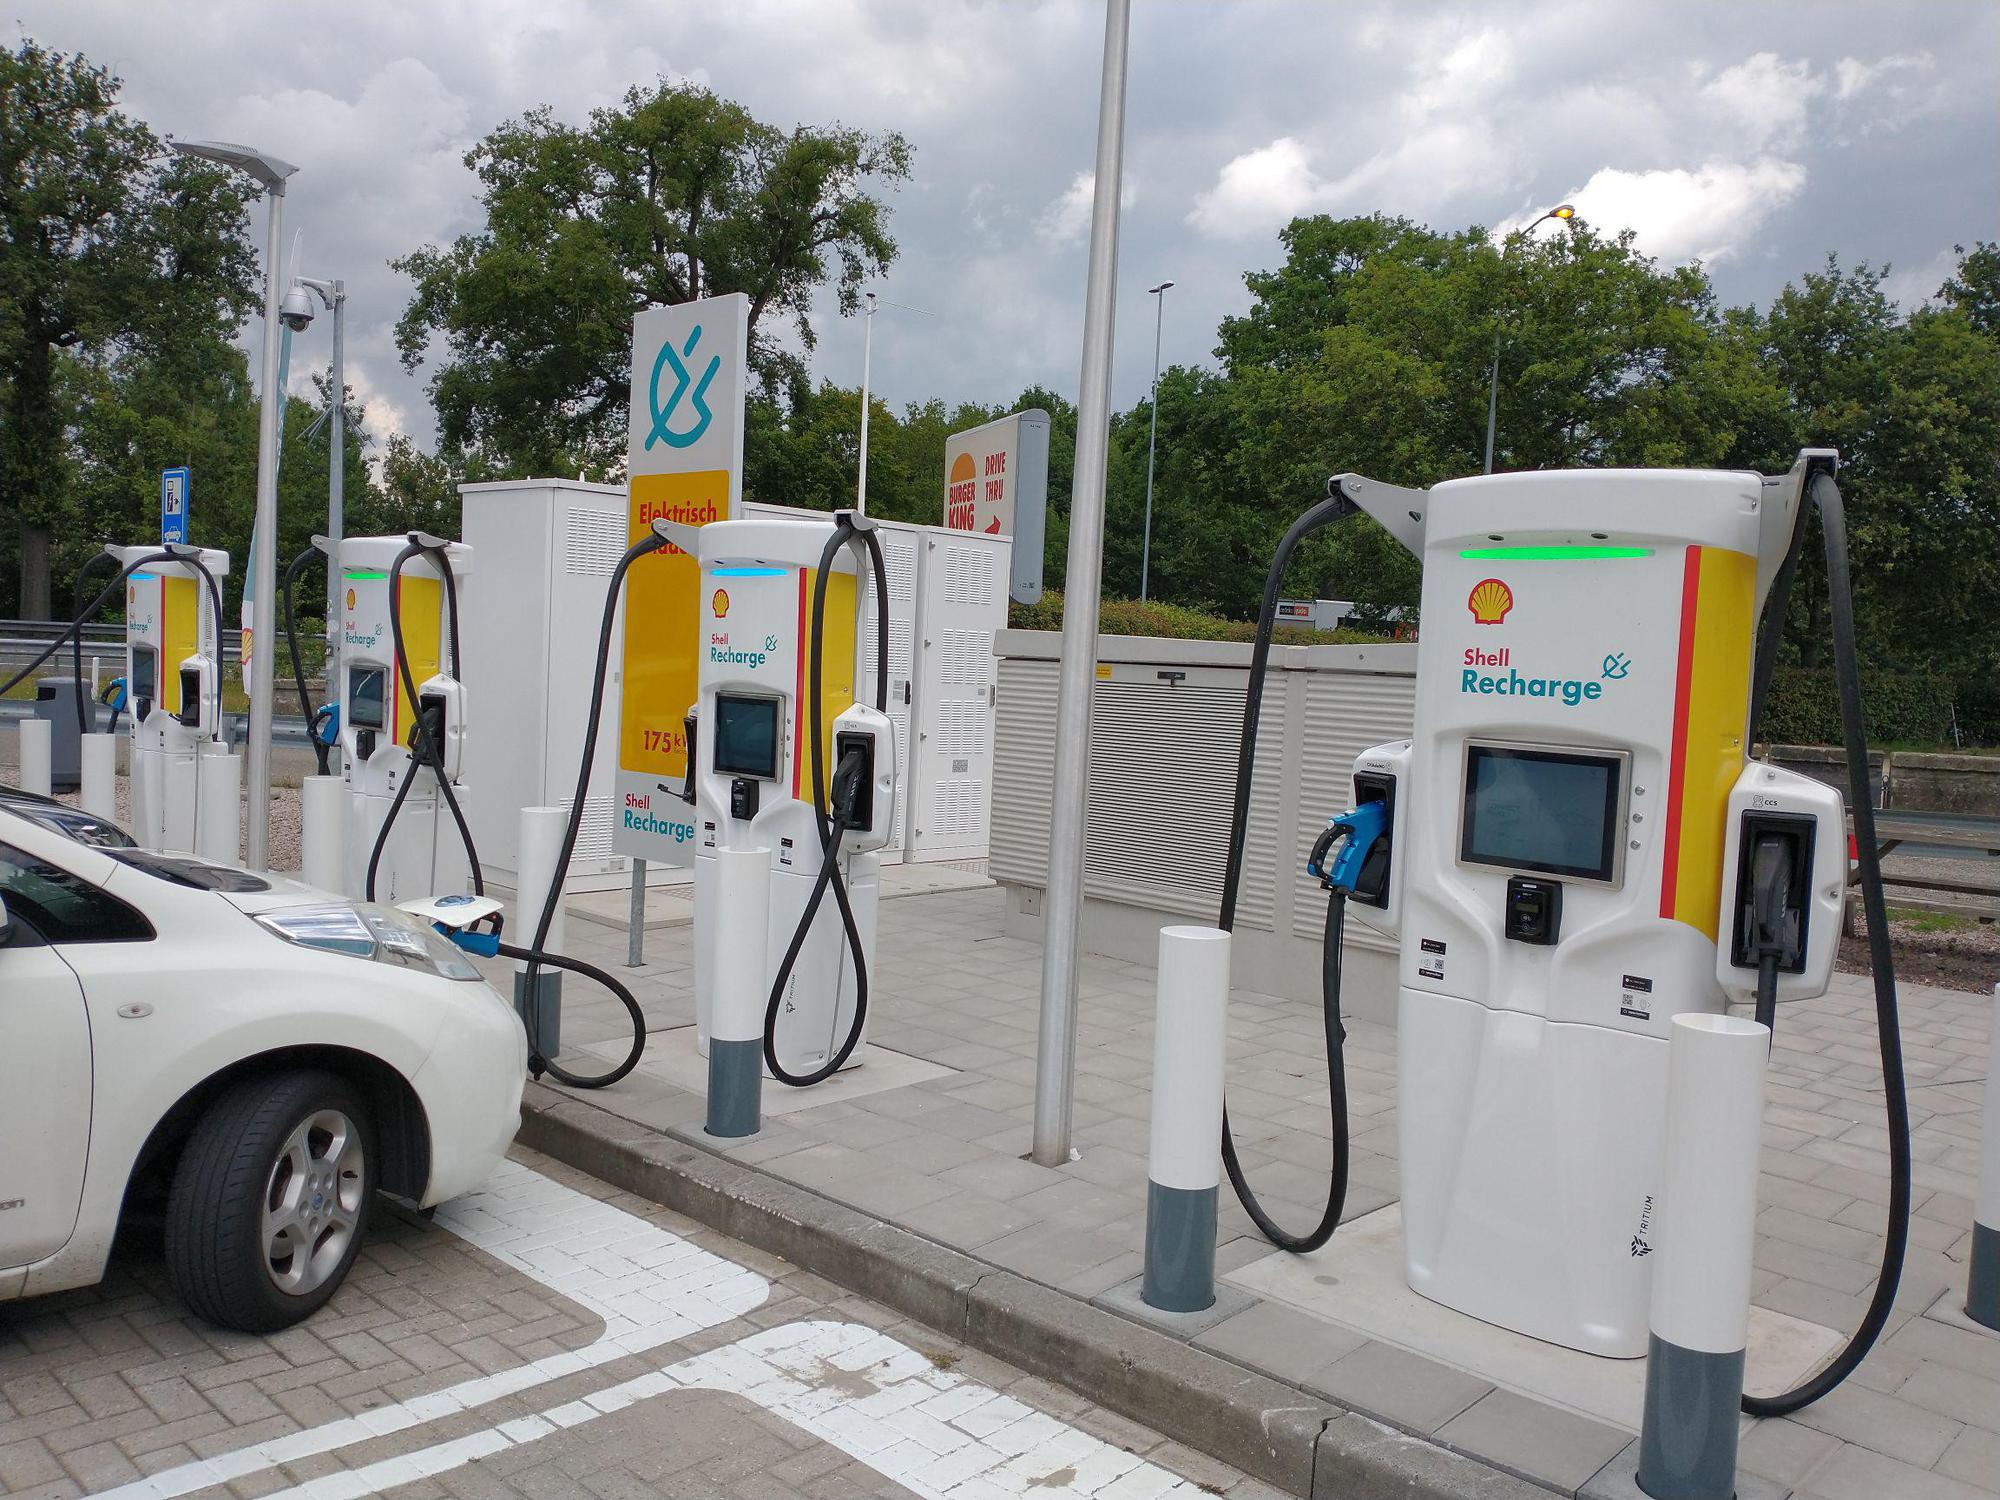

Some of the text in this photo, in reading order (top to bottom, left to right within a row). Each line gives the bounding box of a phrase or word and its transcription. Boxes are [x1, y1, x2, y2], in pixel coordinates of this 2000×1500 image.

[985, 452, 1006, 476] DRIVE
[949, 482, 976, 505] BURGER
[985, 479, 1004, 502] THRU
[640, 499, 717, 524] Elektrisch
[948, 503, 975, 531] KING
[711, 633, 729, 645] Shell
[711, 647, 766, 669] Recharge
[1463, 647, 1510, 667] Shell
[1461, 668, 1602, 706] Recharge
[644, 730, 687, 753] 175 k
[625, 793, 650, 809] Shell
[624, 809, 695, 843] Recharge
[1639, 1195, 1654, 1235] TRITIUM
